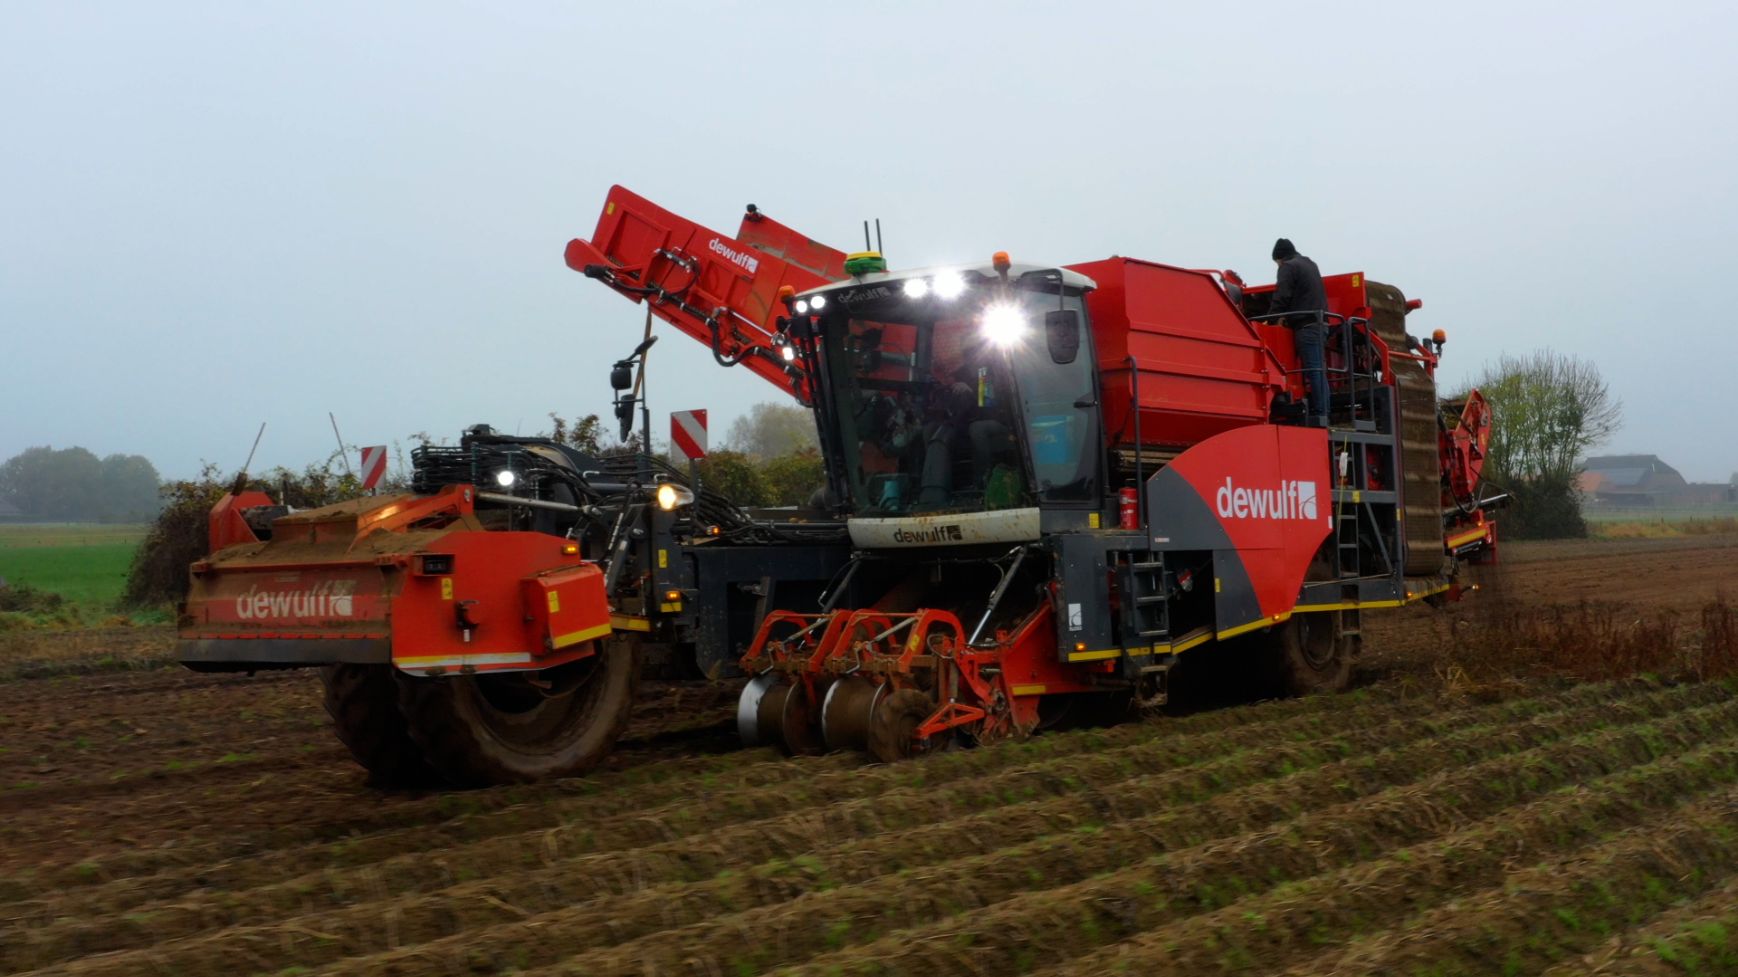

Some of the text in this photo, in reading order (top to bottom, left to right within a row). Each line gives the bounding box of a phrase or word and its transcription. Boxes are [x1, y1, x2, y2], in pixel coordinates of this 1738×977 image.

[709, 238, 750, 269] dewulf
[1217, 476, 1297, 519] dewulf
[894, 525, 946, 543] dewulf
[237, 581, 331, 619] dewulf
